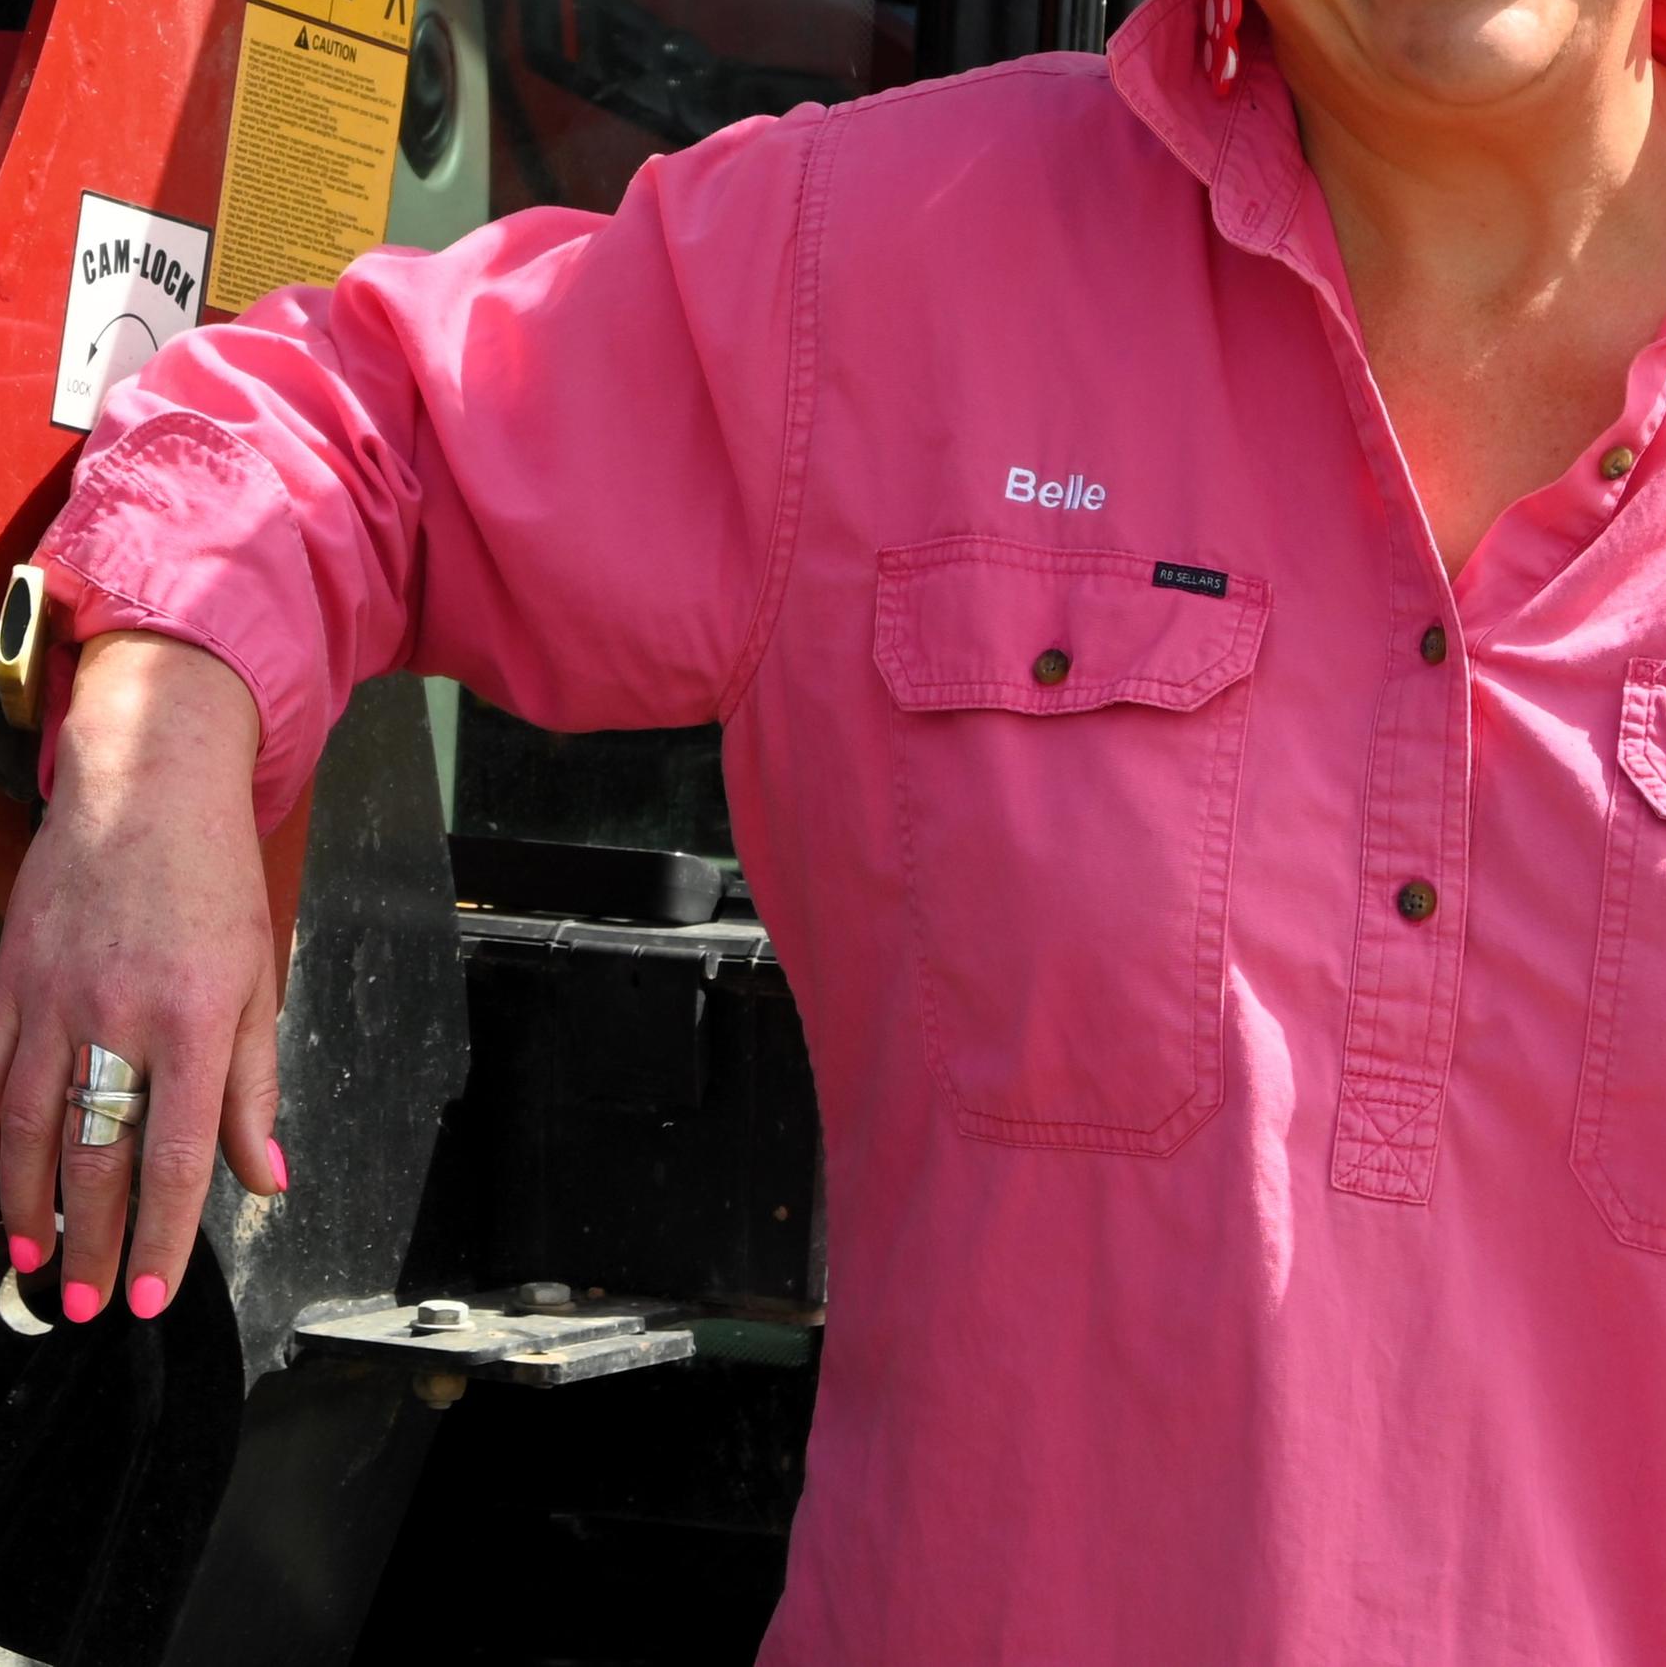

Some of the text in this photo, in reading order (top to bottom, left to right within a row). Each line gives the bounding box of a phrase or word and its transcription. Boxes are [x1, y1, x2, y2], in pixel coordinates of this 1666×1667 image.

[312, 34, 357, 63] CAUTION
[82, 238, 196, 312] CAM-LOCK
[66, 379, 92, 398] LOCK
[1004, 466, 1107, 511] Belle
[1160, 569, 1221, 589] RB SELLARS
